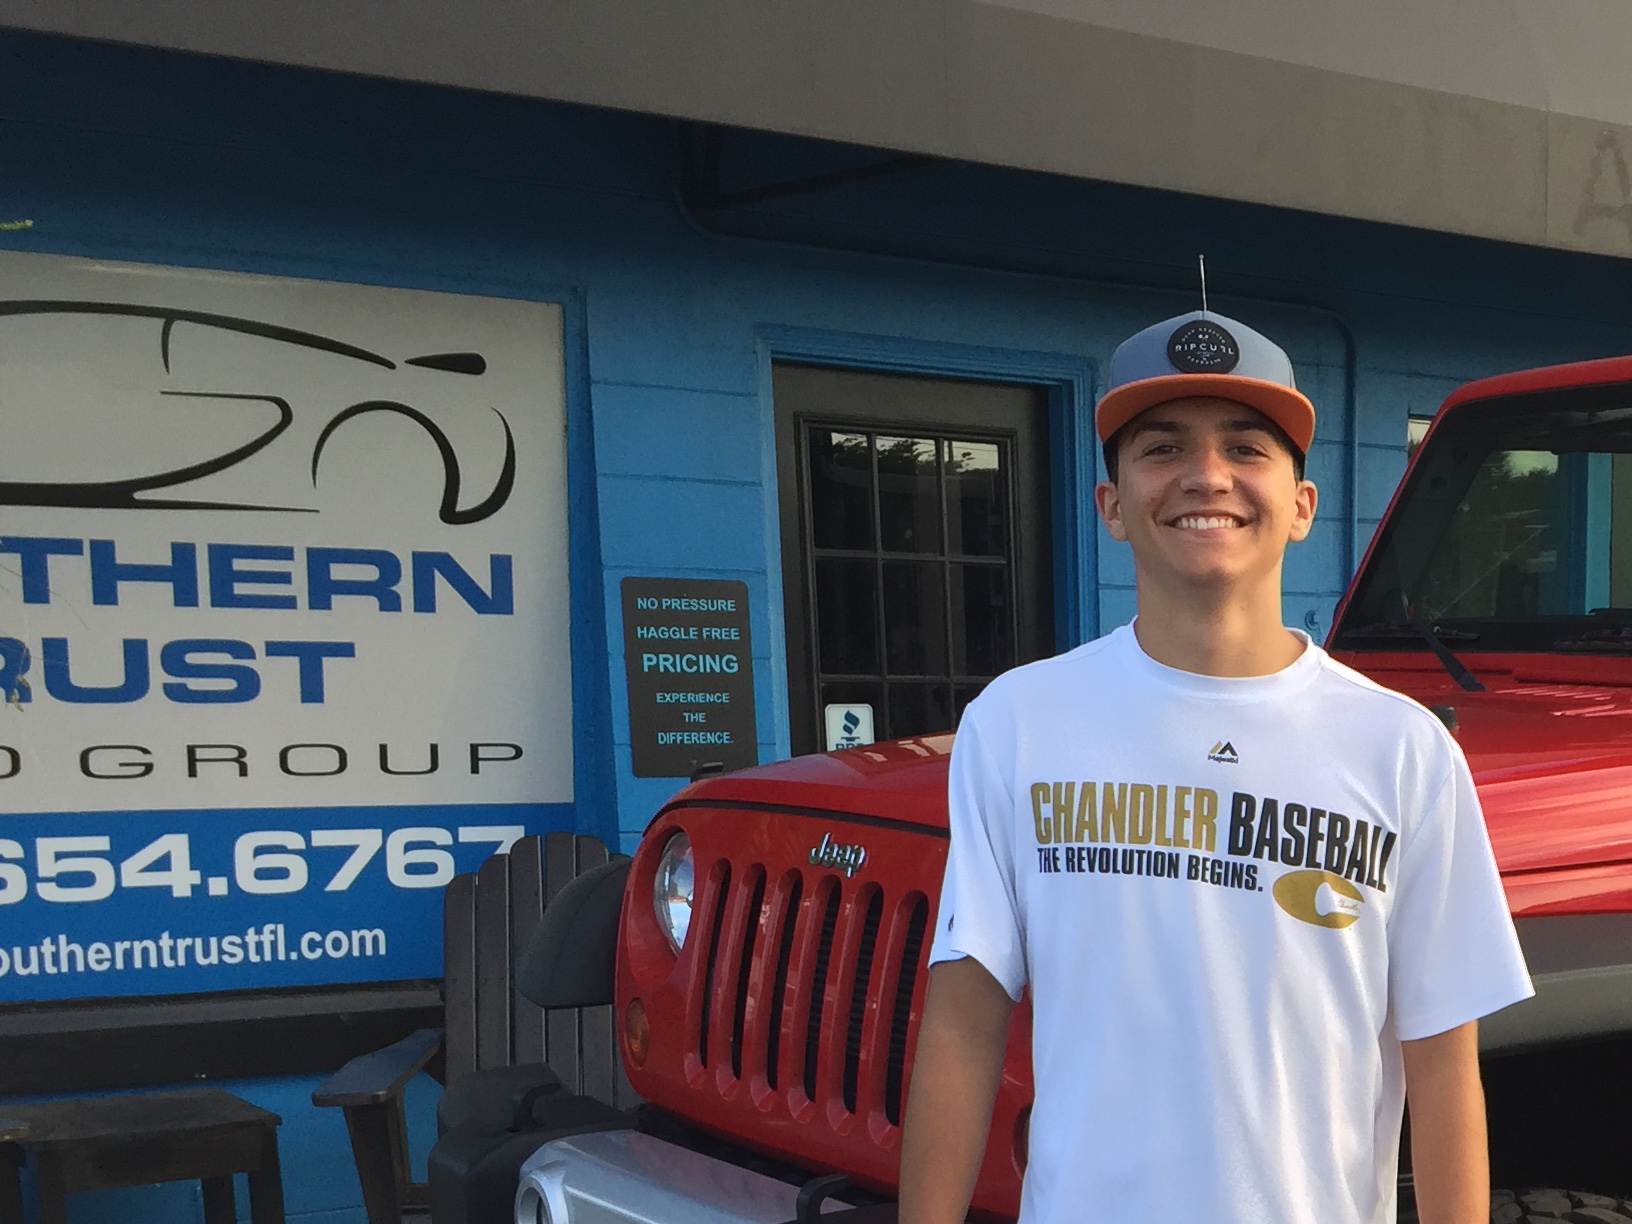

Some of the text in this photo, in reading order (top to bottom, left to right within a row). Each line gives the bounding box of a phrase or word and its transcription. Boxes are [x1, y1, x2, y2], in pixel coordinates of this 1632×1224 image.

[637, 598, 736, 611] NO PRESSURE
[637, 627, 740, 640] HAGGLE FREE
[642, 653, 739, 673] PRICING
[656, 692, 730, 703] EXPERIENCE
[683, 712, 706, 723] THE
[658, 732, 734, 744] DIFFERENCE.
[79, 742, 525, 780] GROUP
[1030, 782, 1397, 892] CHANDLER BASEBALL
[809, 832, 867, 878] Jeep
[1037, 847, 1263, 892] THE REVOLUTION BEGINS.
